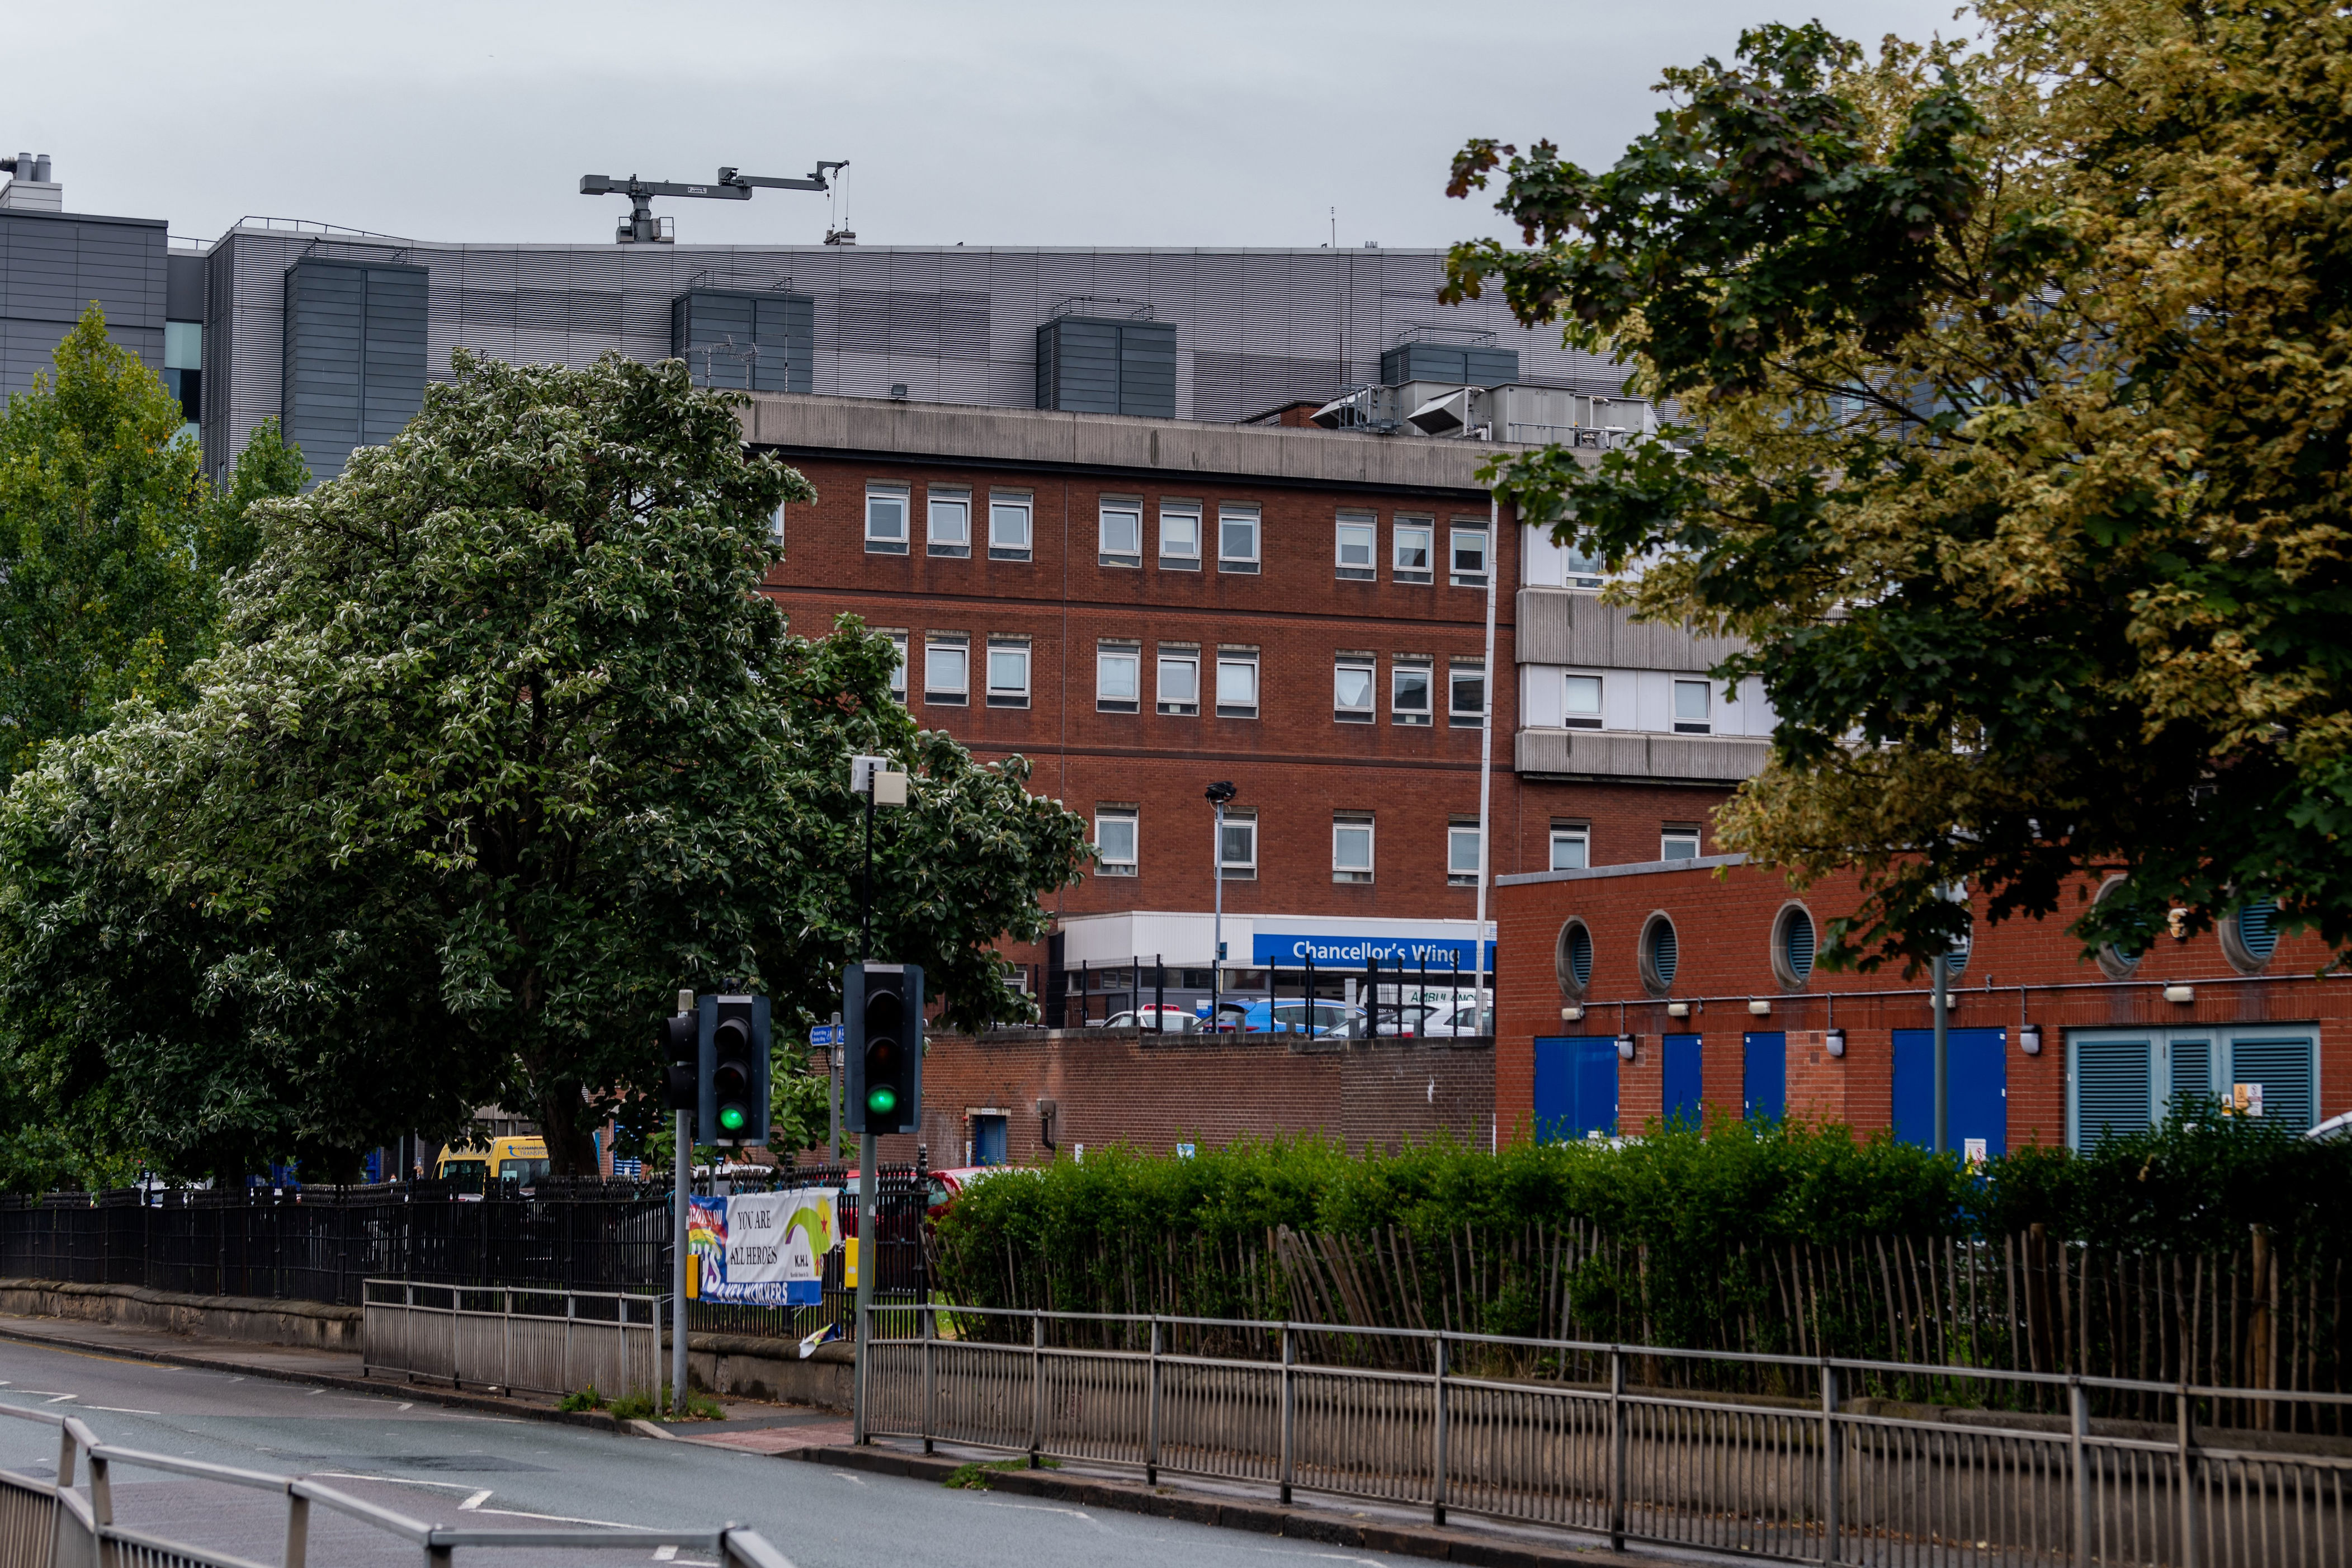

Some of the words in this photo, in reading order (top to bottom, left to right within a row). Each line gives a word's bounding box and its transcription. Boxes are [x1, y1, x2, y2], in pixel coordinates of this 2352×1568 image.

[1293, 941, 1406, 961] Chancellor's
[1411, 944, 1460, 967] Wing
[706, 1209, 722, 1228] you
[738, 1211, 753, 1230] YOU
[755, 1211, 771, 1229] ARE
[730, 1247, 745, 1265] ALL
[746, 1246, 777, 1265] HEROES
[725, 1283, 744, 1303] KEY
[744, 1282, 788, 1304] WORKERS
